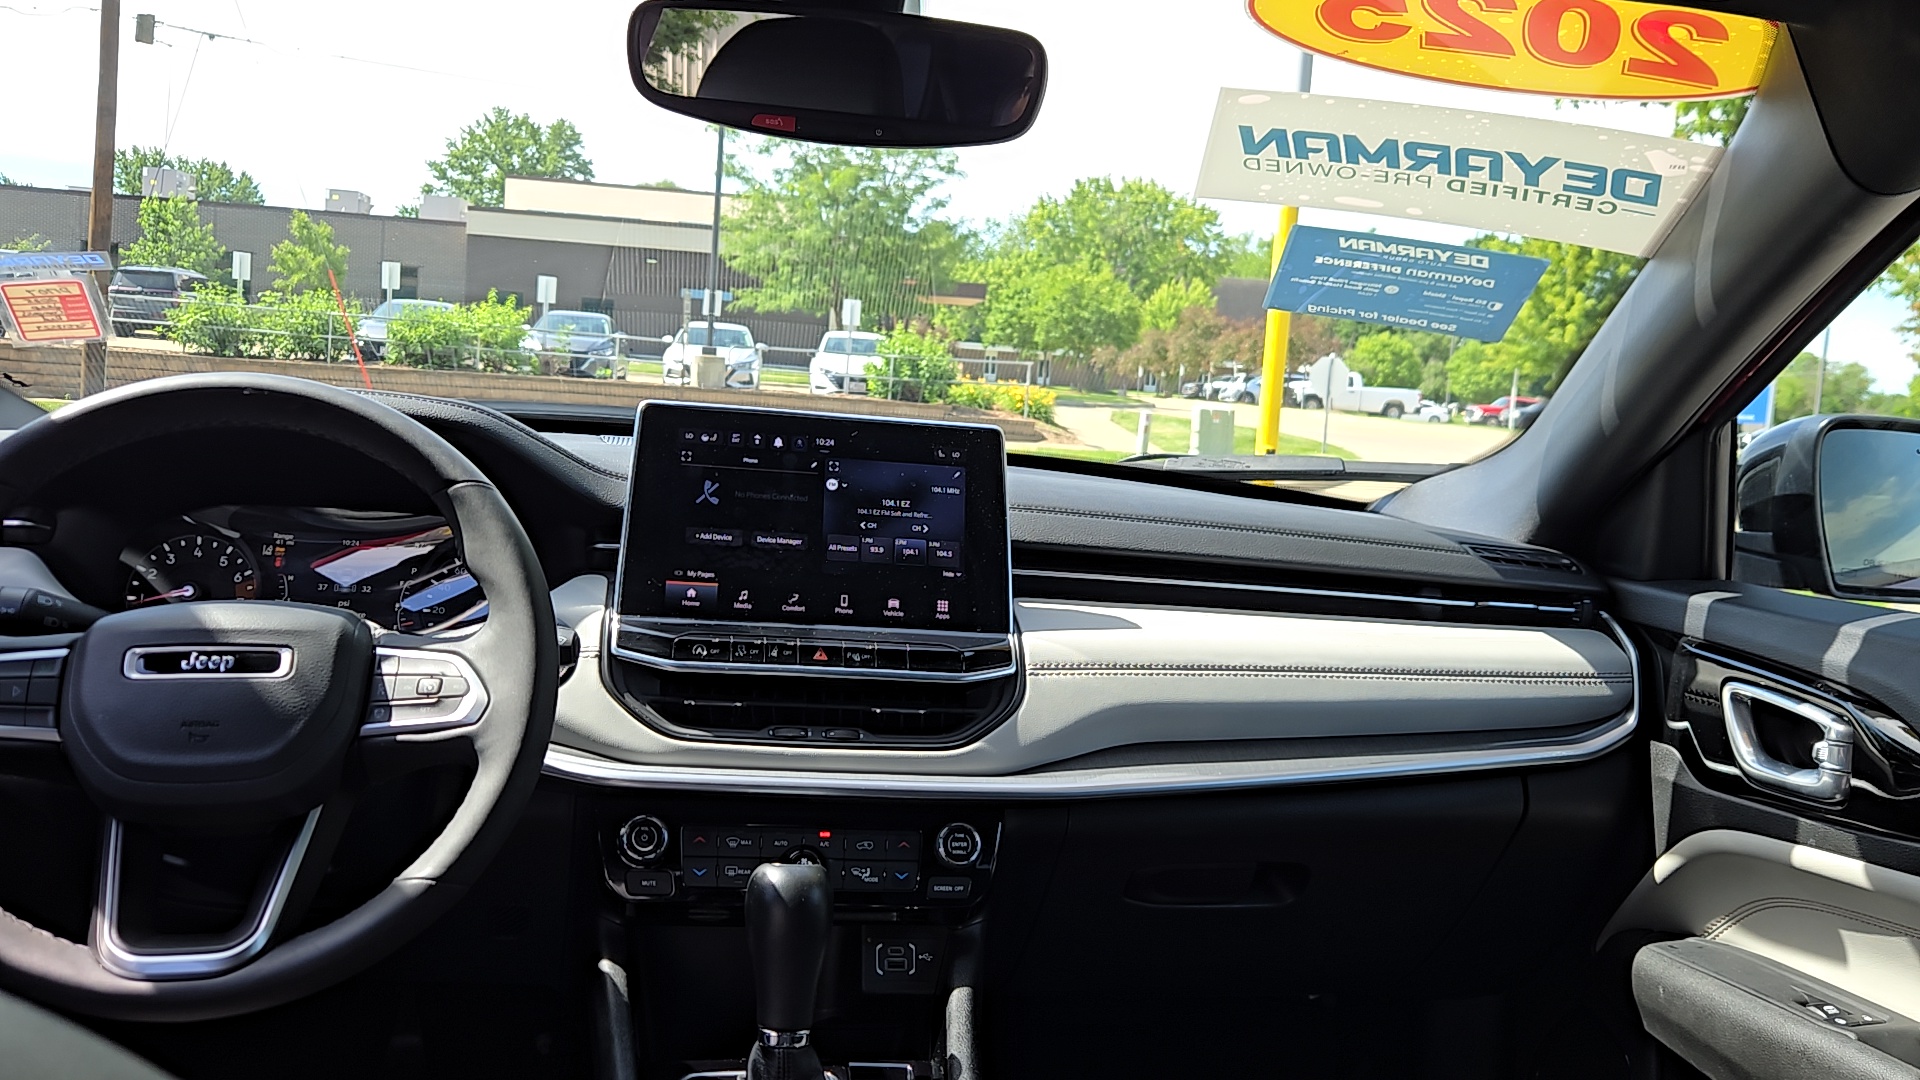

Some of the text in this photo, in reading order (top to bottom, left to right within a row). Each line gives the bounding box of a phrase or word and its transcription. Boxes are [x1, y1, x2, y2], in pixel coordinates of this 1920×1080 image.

[815, 438, 835, 447] 10:24
[734, 490, 746, 498] No
[882, 499, 911, 508] 104.1 EZ
[342, 539, 360, 547] 10:24
[756, 536, 803, 545] Device Manager
[193, 546, 203, 558] 4
[837, 544, 858, 552] Presets
[902, 548, 919, 556] 104.1
[165, 552, 176, 565] 3
[219, 555, 229, 567] 5
[147, 568, 158, 580] 2
[233, 572, 243, 583] 6
[686, 570, 697, 578] My
[317, 583, 329, 591] 37
[337, 600, 351, 608] psi
[733, 602, 752, 610] Media
[781, 604, 806, 612] Comfort
[834, 607, 854, 615] Phone
[882, 609, 904, 617] Vehicle
[935, 612, 951, 620] Apps
[181, 651, 236, 673] Jeep
[737, 868, 752, 876] REAR
